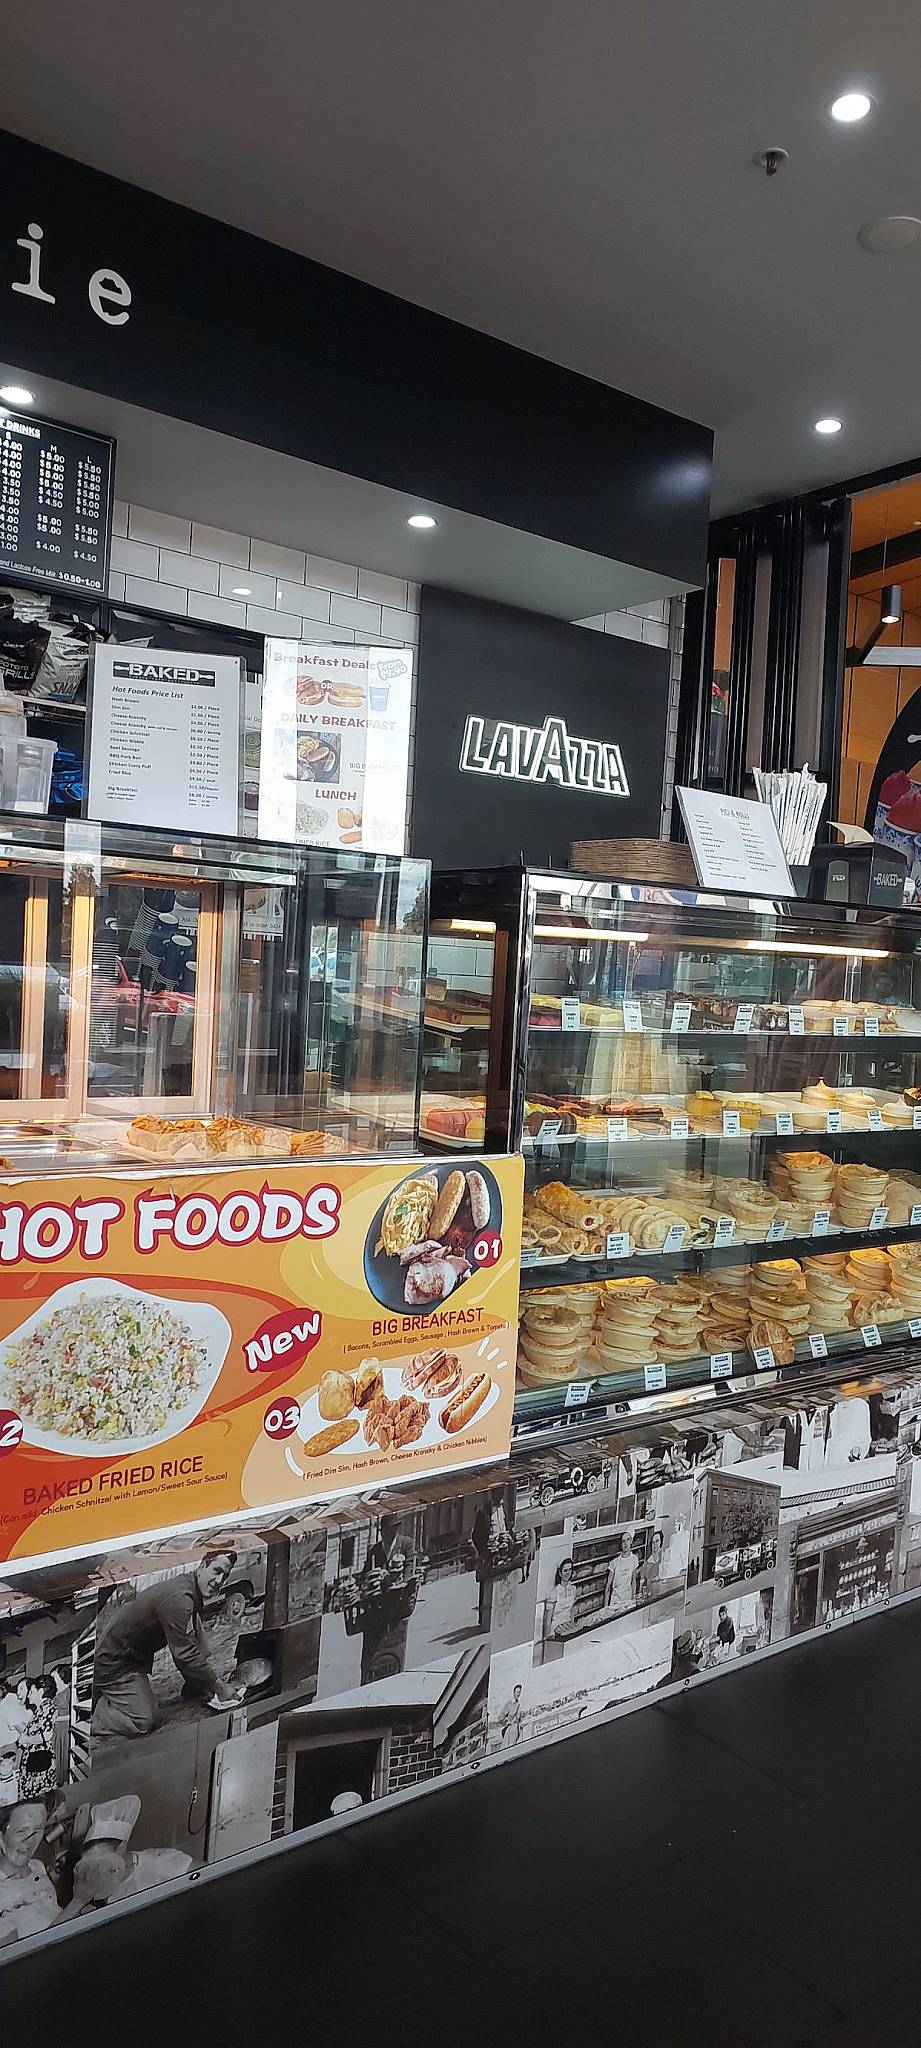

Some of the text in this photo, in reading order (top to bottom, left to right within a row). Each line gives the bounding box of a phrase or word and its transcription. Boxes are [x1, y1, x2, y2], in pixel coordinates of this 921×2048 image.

[7, 420, 40, 438] DRINKS
[50, 444, 57, 453] M
[274, 652, 376, 670] Breakfast Deals
[129, 663, 200, 682] BAKED
[112, 686, 126, 694] Hot
[127, 688, 149, 696] Foods
[151, 690, 169, 698] Price
[321, 682, 334, 690] OR
[281, 713, 396, 730] DAILY BREAKFAST
[460, 715, 630, 799] LAVAZZA
[315, 789, 357, 801] LUNCH
[876, 873, 898, 886] BAKED
[138, 1187, 338, 1250] FOODS
[474, 1239, 500, 1260] 01
[372, 1308, 484, 1336] BIG BREAKFAST
[245, 1313, 320, 1370] New
[372, 1337, 403, 1348] Scrambled
[447, 1328, 462, 1337] Hash
[462, 1326, 480, 1335] Brown
[265, 1406, 300, 1432] 03
[307, 1470, 324, 1479] Fried
[324, 1467, 337, 1476] Dim
[338, 1464, 351, 1473] Sim,
[353, 1460, 368, 1470] Hash
[369, 1457, 390, 1466] Brown,
[391, 1452, 413, 1462] Cheese
[414, 1448, 436, 1458] Kransky
[443, 1441, 465, 1451] Chicken
[23, 1456, 204, 1506] BAKED FRIED RICE
[41, 1503, 74, 1516] Chicken
[76, 1494, 112, 1509] Schnitzel
[114, 1491, 131, 1501] with
[132, 1481, 185, 1497] Lemon/Sweet
[186, 1478, 203, 1487] Sour
